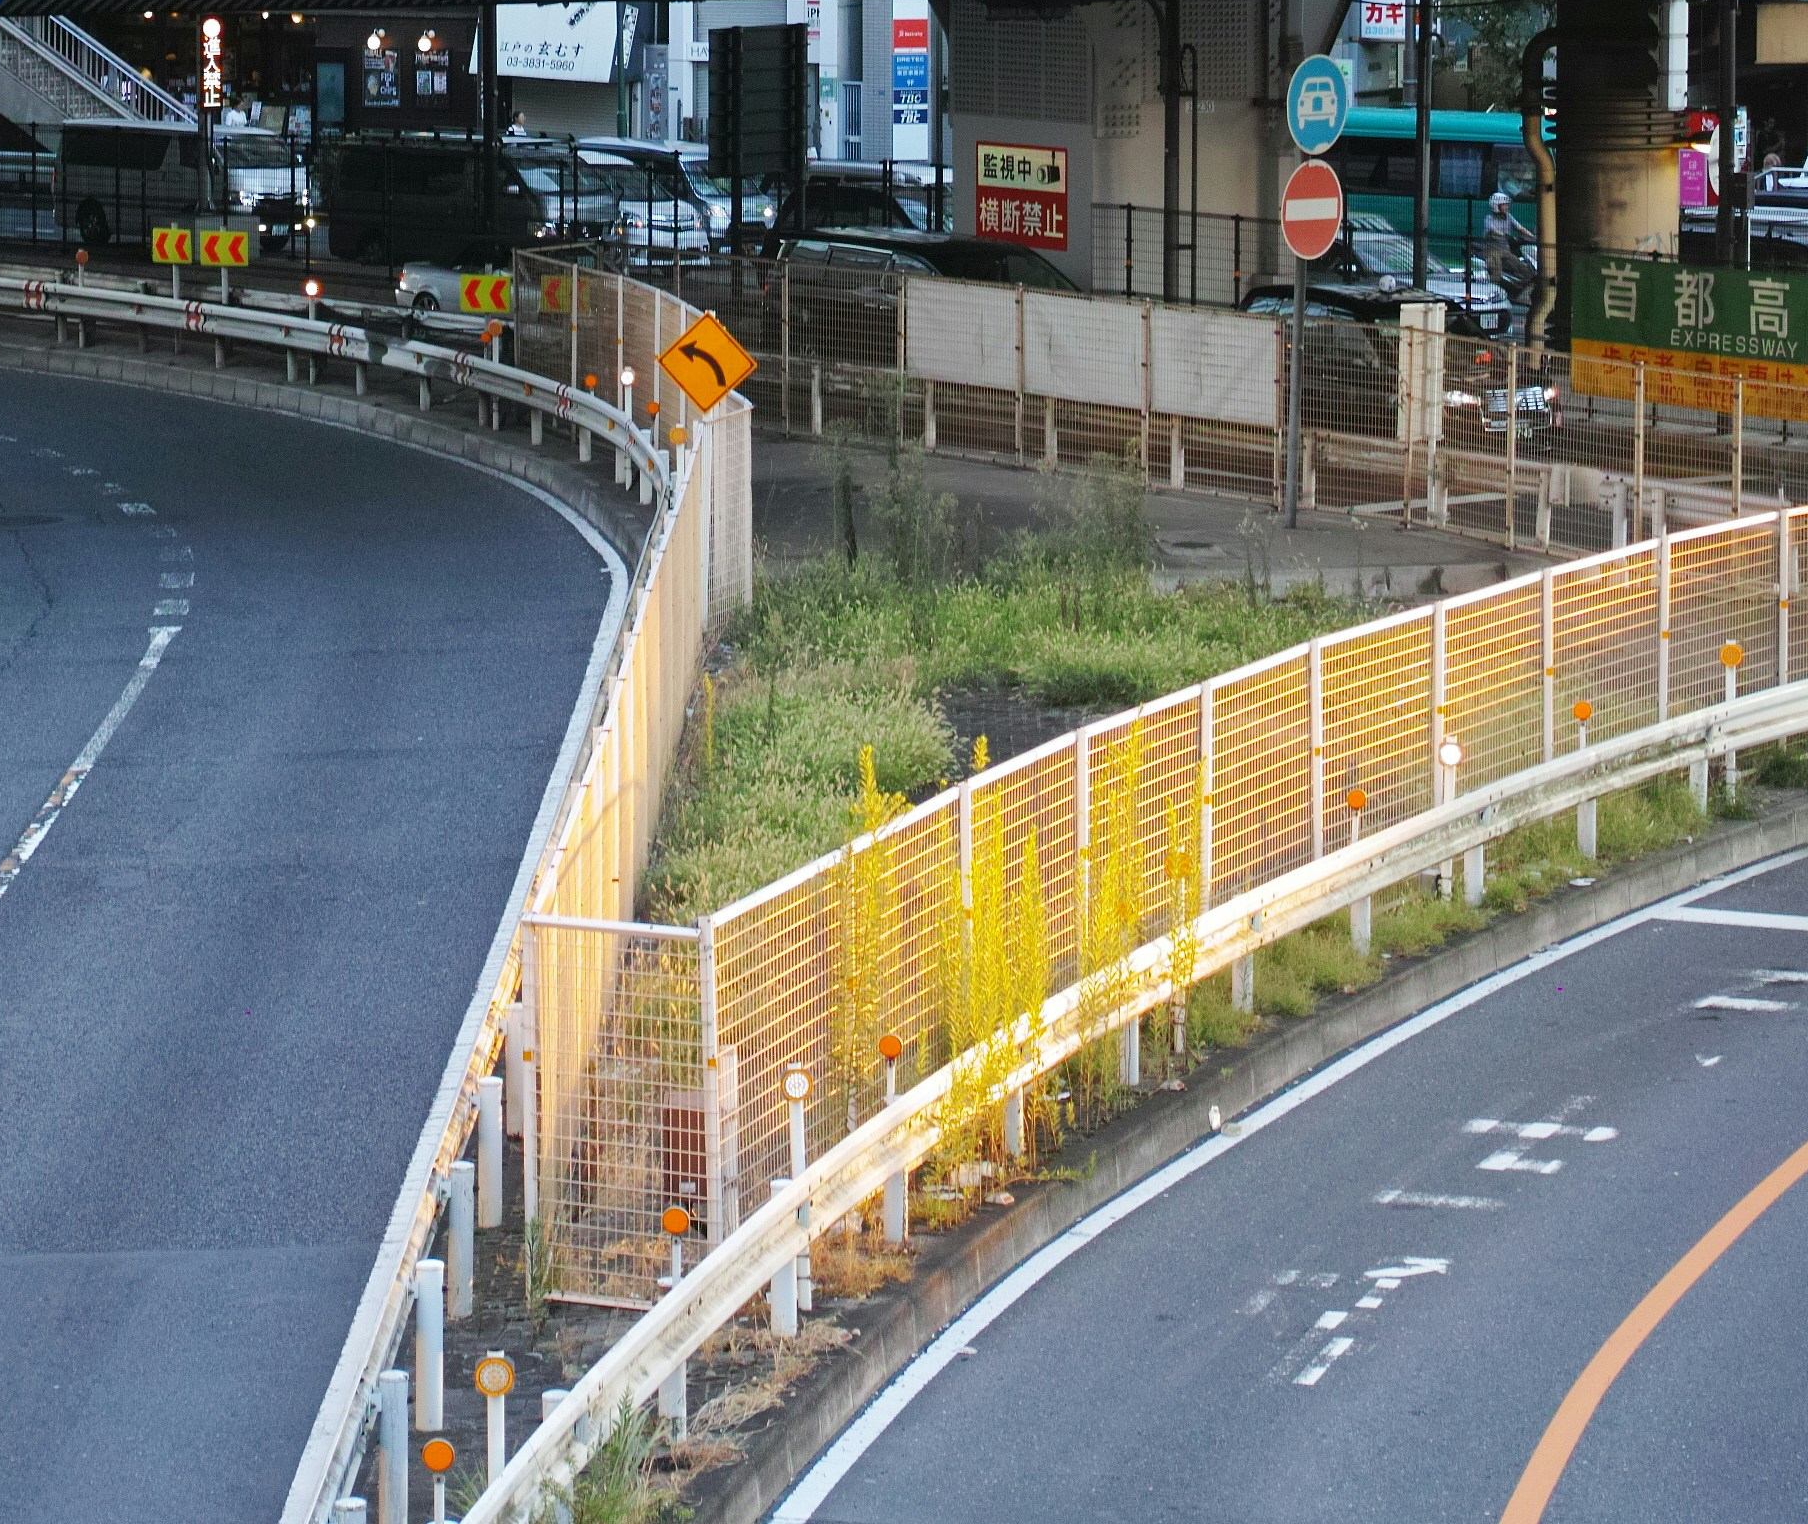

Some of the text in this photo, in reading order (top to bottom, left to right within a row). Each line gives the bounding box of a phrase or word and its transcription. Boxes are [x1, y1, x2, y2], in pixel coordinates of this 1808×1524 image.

[203, 37, 221, 108] 進入禁止
[983, 153, 1032, 182] 監視中
[979, 196, 1064, 239] 横断禁止
[1670, 329, 1798, 359] EXPRESSWAY
